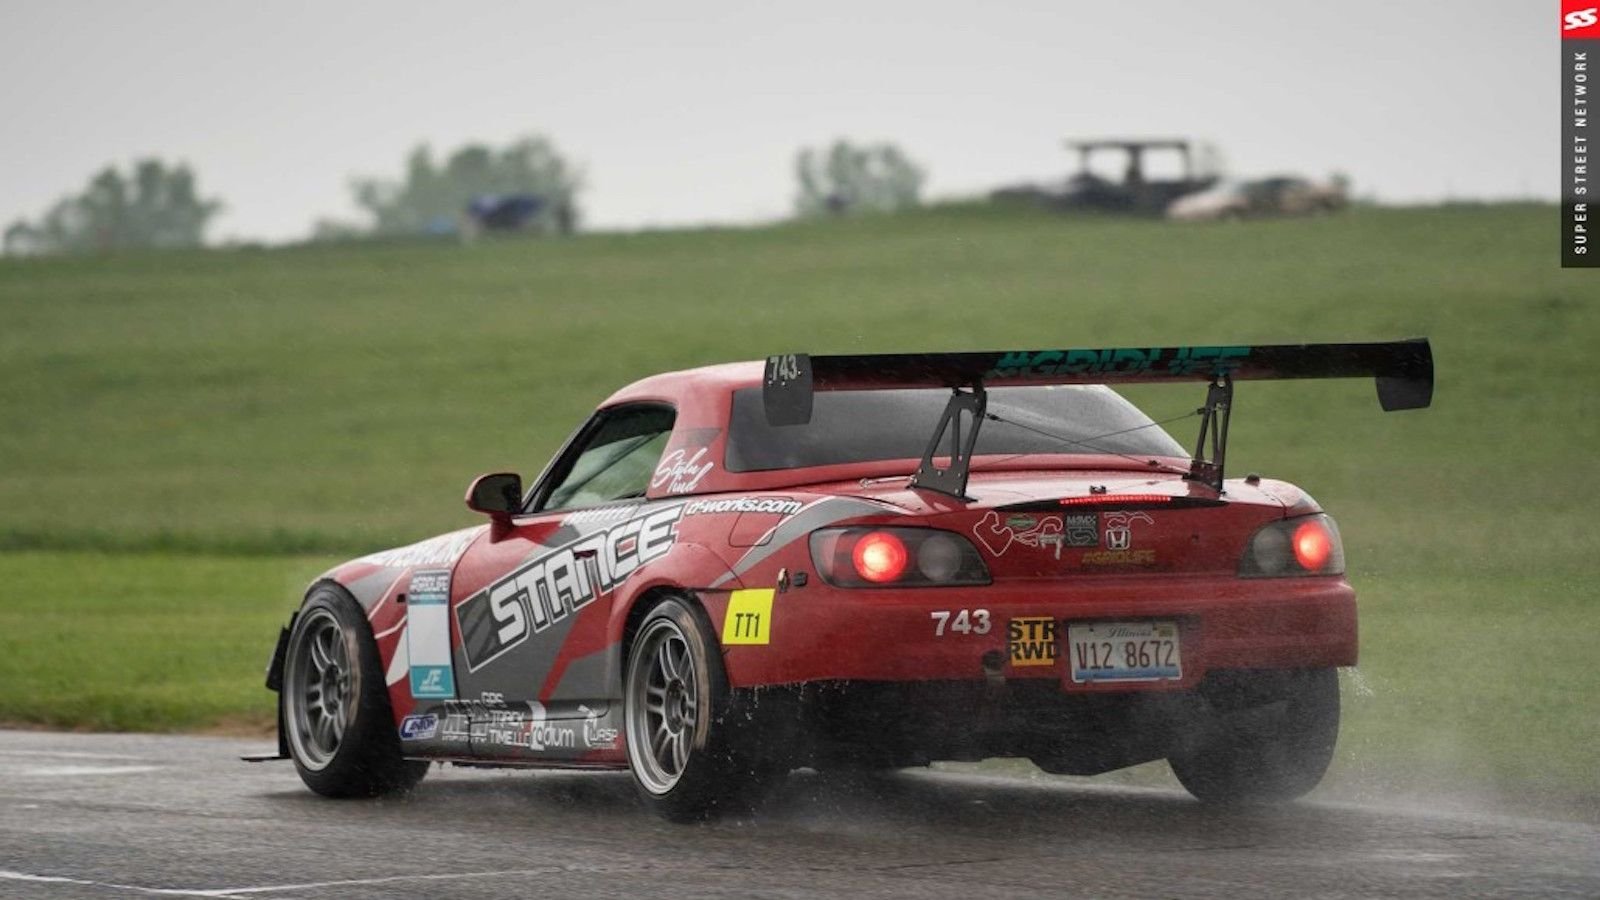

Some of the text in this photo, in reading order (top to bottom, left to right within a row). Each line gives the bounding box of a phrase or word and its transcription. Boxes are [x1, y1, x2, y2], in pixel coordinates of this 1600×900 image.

[769, 355, 798, 381] 743
[489, 503, 685, 647] STANCE
[734, 612, 761, 638] TT1
[931, 608, 993, 637] 743
[1075, 639, 1178, 670] V12 8672
